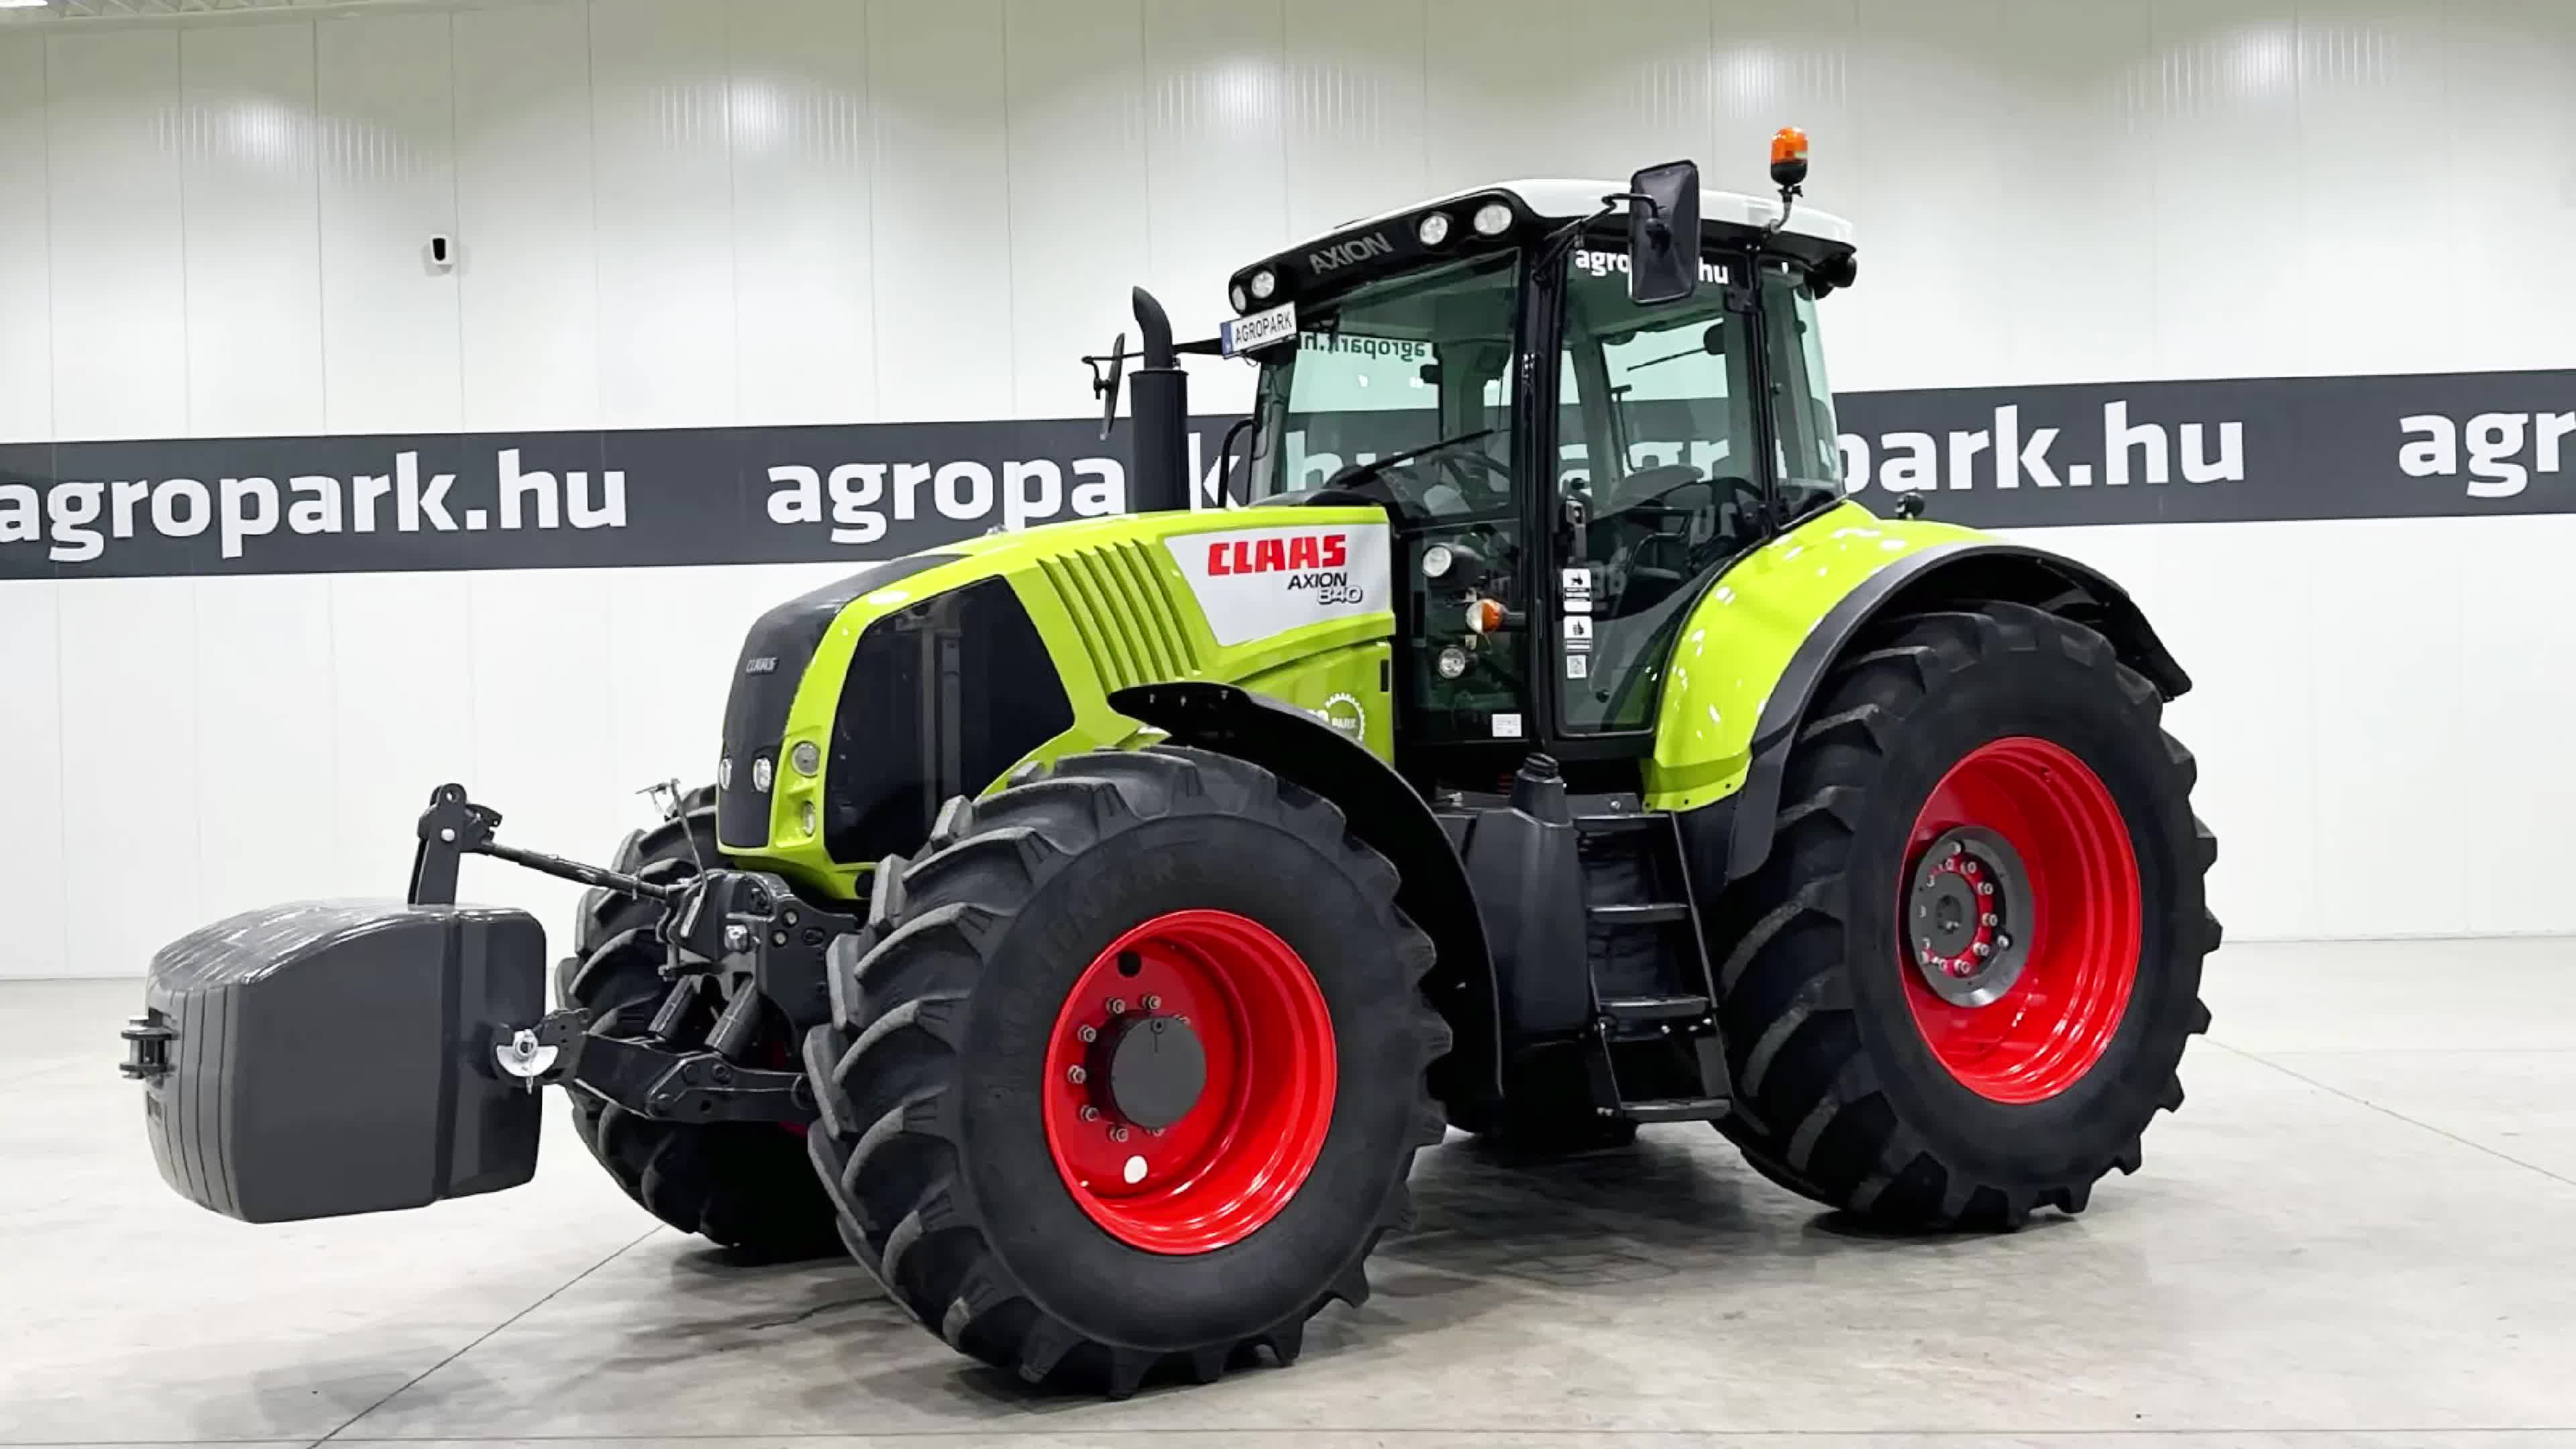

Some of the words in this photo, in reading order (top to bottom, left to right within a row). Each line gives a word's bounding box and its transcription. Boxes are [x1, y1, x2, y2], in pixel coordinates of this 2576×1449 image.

[1309, 231, 1394, 274] AXION
[1576, 249, 1729, 284] agrohu
[1235, 311, 1292, 343] AGROPARK
[2398, 411, 2576, 498] agr
[0, 448, 627, 563] agropark.hu
[766, 430, 1415, 543] agropakh
[1208, 534, 1346, 577] CLAAS
[1287, 572, 1348, 590] AXION
[1318, 585, 1362, 605] 840
